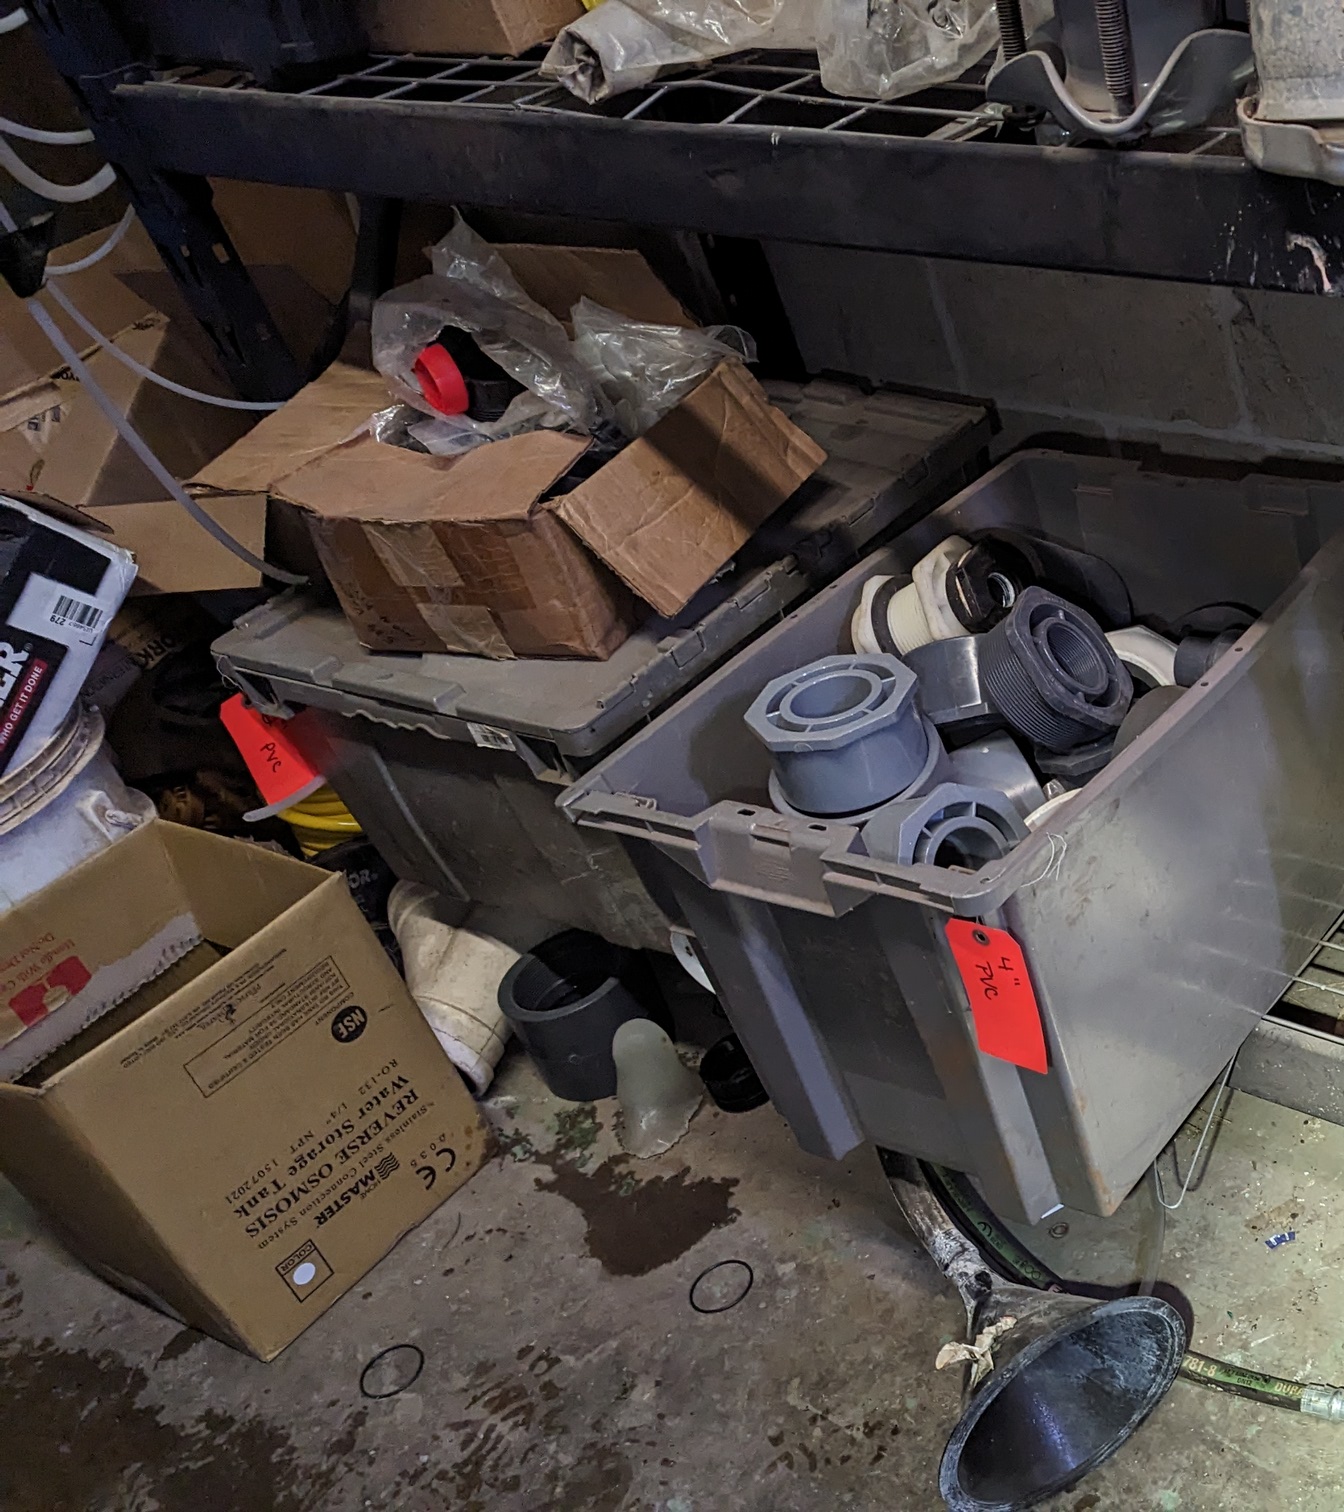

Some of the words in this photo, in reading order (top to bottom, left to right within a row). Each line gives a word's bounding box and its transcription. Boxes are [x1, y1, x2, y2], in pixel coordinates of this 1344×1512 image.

[50, 614, 66, 626] 279
[10, 703, 23, 722] GET
[18, 692, 29, 703] IT
[25, 666, 43, 693] DONE
[975, 961, 999, 1000] PVC
[332, 1008, 365, 1038] NSF
[355, 1073, 407, 1120] Water
[358, 1058, 397, 1094] RO-132
[285, 1116, 354, 1179] Storage
[288, 1130, 312, 1153] NPT
[334, 1089, 419, 1164] REVERSE
[359, 1144, 383, 1167] Steel
[415, 1148, 456, 1190] CE
[225, 1157, 277, 1204] 15072021
[234, 1175, 284, 1221] Tank
[245, 1160, 333, 1239] OSMOSIS
[300, 1167, 356, 1217] Connection
[314, 1169, 376, 1226] MASTER
[258, 1215, 296, 1251] System
[280, 1243, 311, 1271] COLOR
